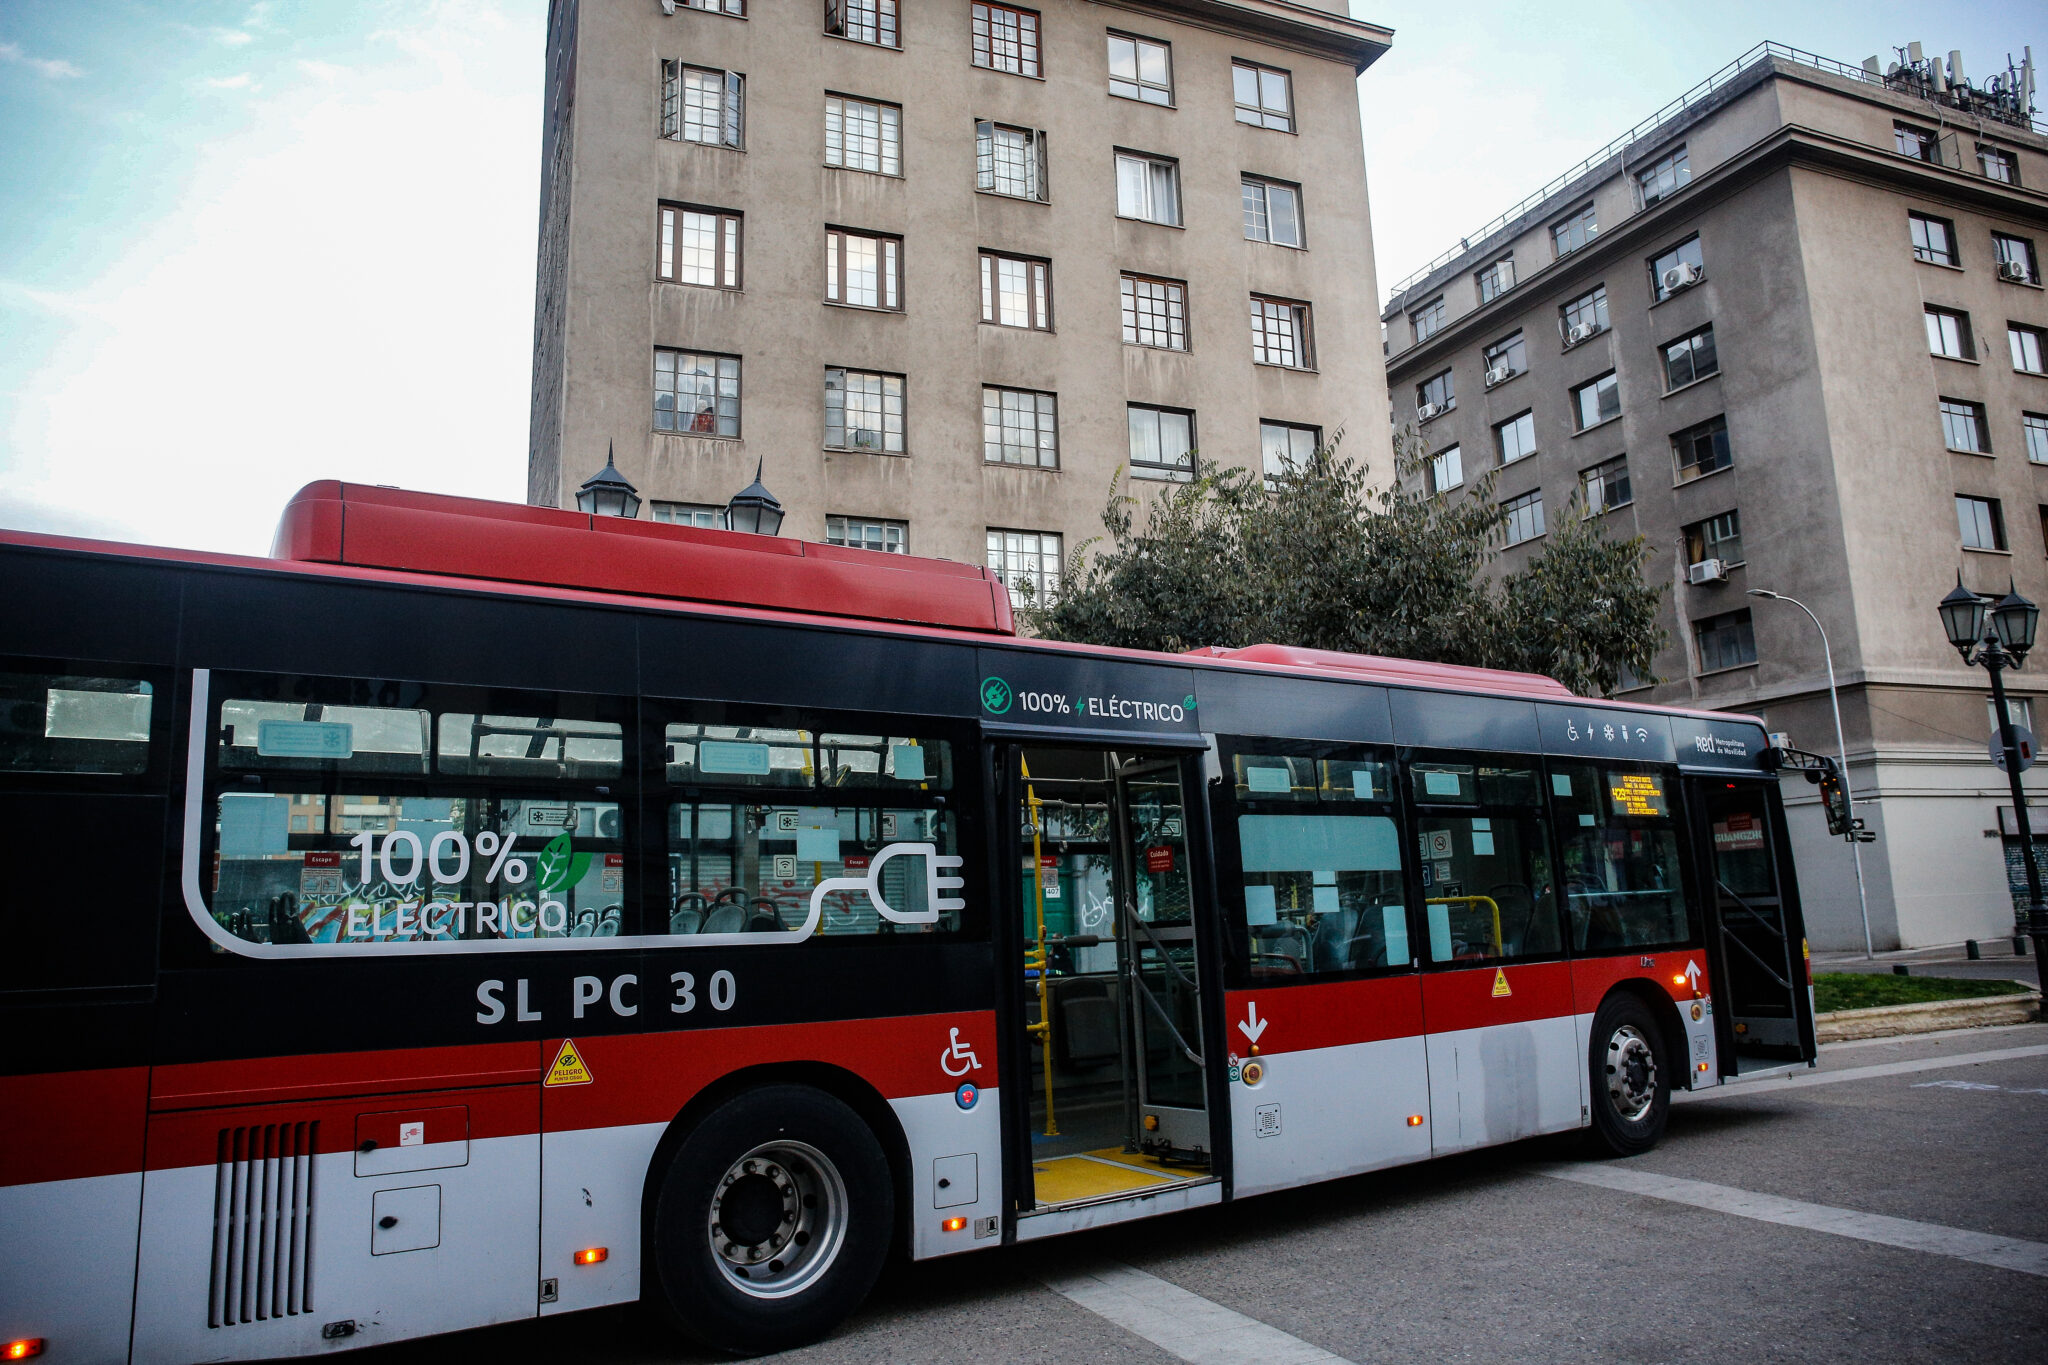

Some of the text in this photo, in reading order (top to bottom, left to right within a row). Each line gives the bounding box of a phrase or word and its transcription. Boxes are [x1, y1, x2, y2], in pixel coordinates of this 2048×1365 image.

[1019, 691, 1184, 722] 100% ELÉCTRICO
[1695, 733, 1715, 753] Red
[1715, 738, 1745, 747] Metropolitana
[1724, 747, 1747, 756] Movilidad
[350, 830, 528, 885] 100%
[1150, 850, 1169, 858] Cuidado
[348, 894, 566, 937] ELÉCTRICO
[476, 969, 736, 1025] SL PC 30
[554, 1068, 583, 1076] PELIGRO
